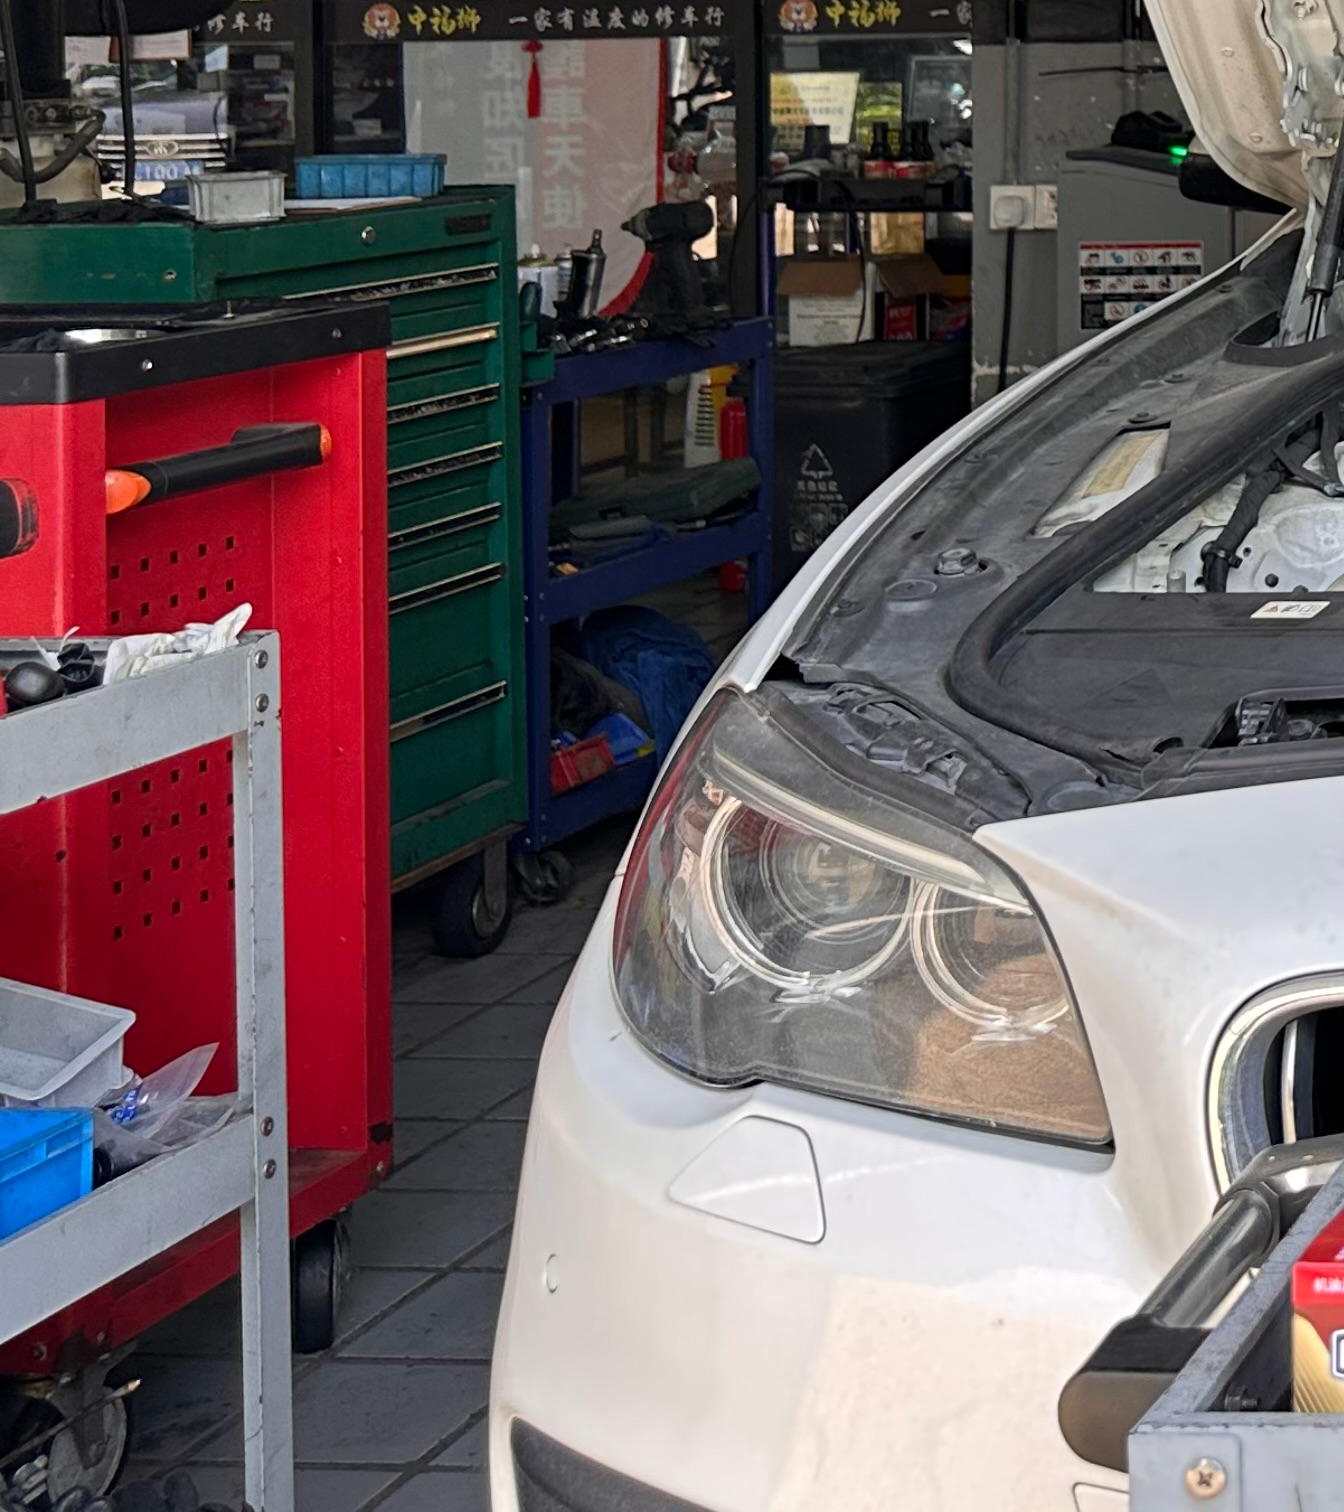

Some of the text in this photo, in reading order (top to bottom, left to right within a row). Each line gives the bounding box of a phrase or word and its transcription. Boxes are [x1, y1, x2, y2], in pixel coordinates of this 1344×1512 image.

[508, 4, 725, 31] 一家有温度的修车行
